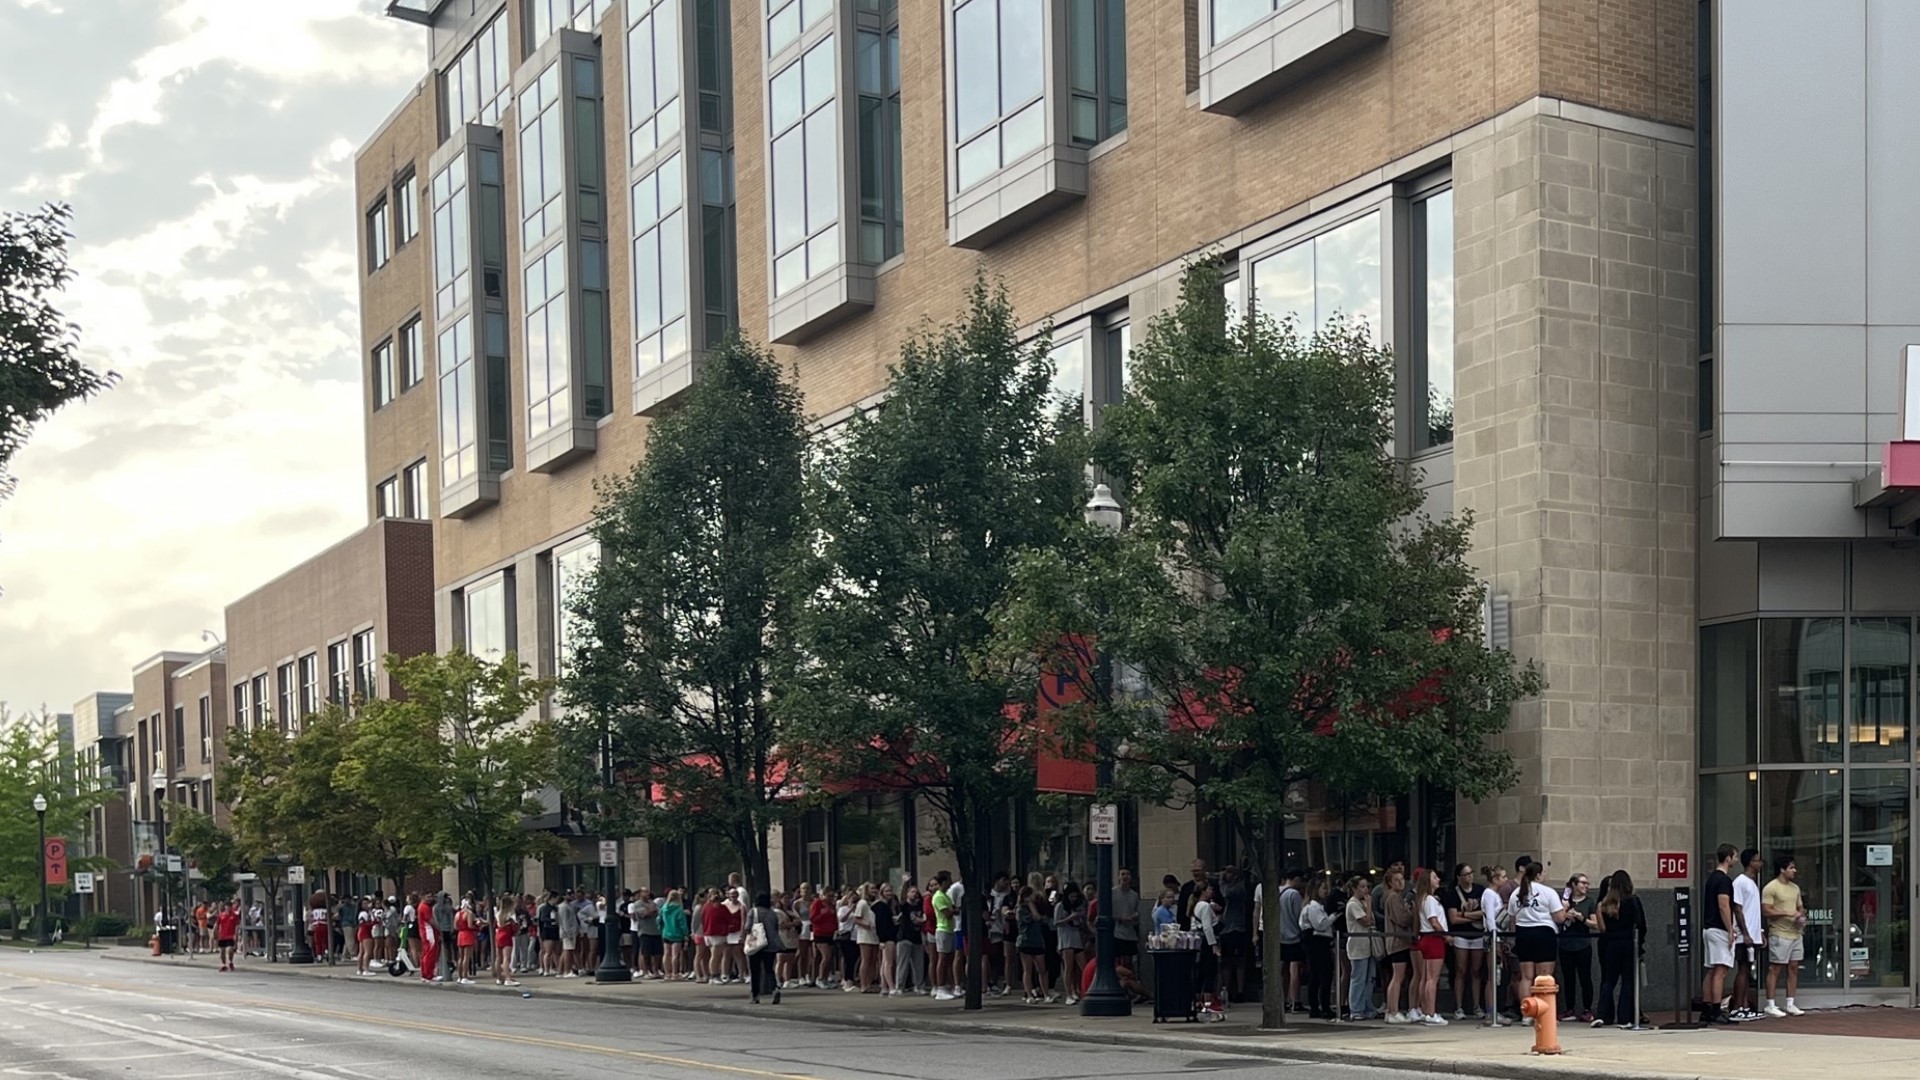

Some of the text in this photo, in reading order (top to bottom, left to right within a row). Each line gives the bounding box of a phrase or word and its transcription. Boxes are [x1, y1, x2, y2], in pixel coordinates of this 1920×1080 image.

[51, 845, 60, 856] P
[1659, 858, 1686, 874] FDC
[1808, 908, 1834, 920] NOBLE
